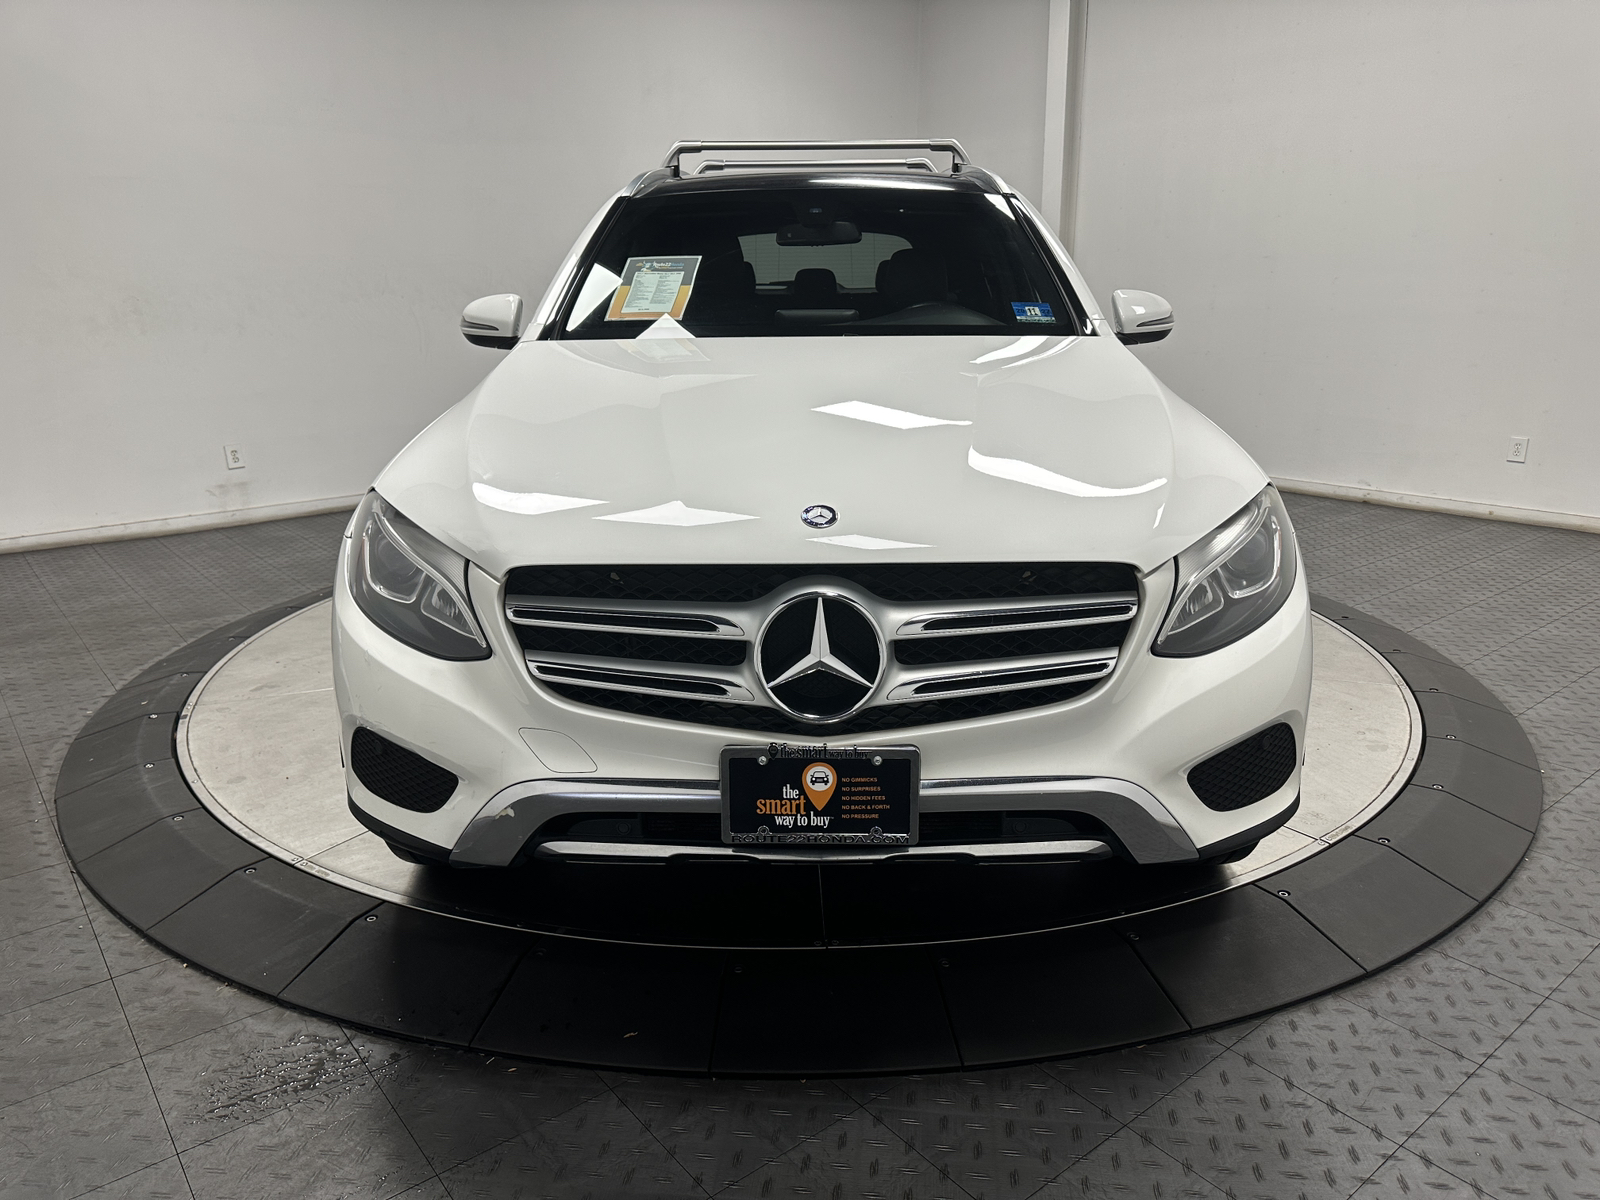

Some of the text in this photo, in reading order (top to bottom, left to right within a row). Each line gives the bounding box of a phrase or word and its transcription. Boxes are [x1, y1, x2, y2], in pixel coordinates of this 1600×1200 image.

[796, 742, 828, 758] smart
[782, 784, 799, 799] the
[756, 795, 806, 815] smart
[774, 811, 830, 829] way to buy
[731, 834, 910, 844] ROUTE22HONDA.COM
